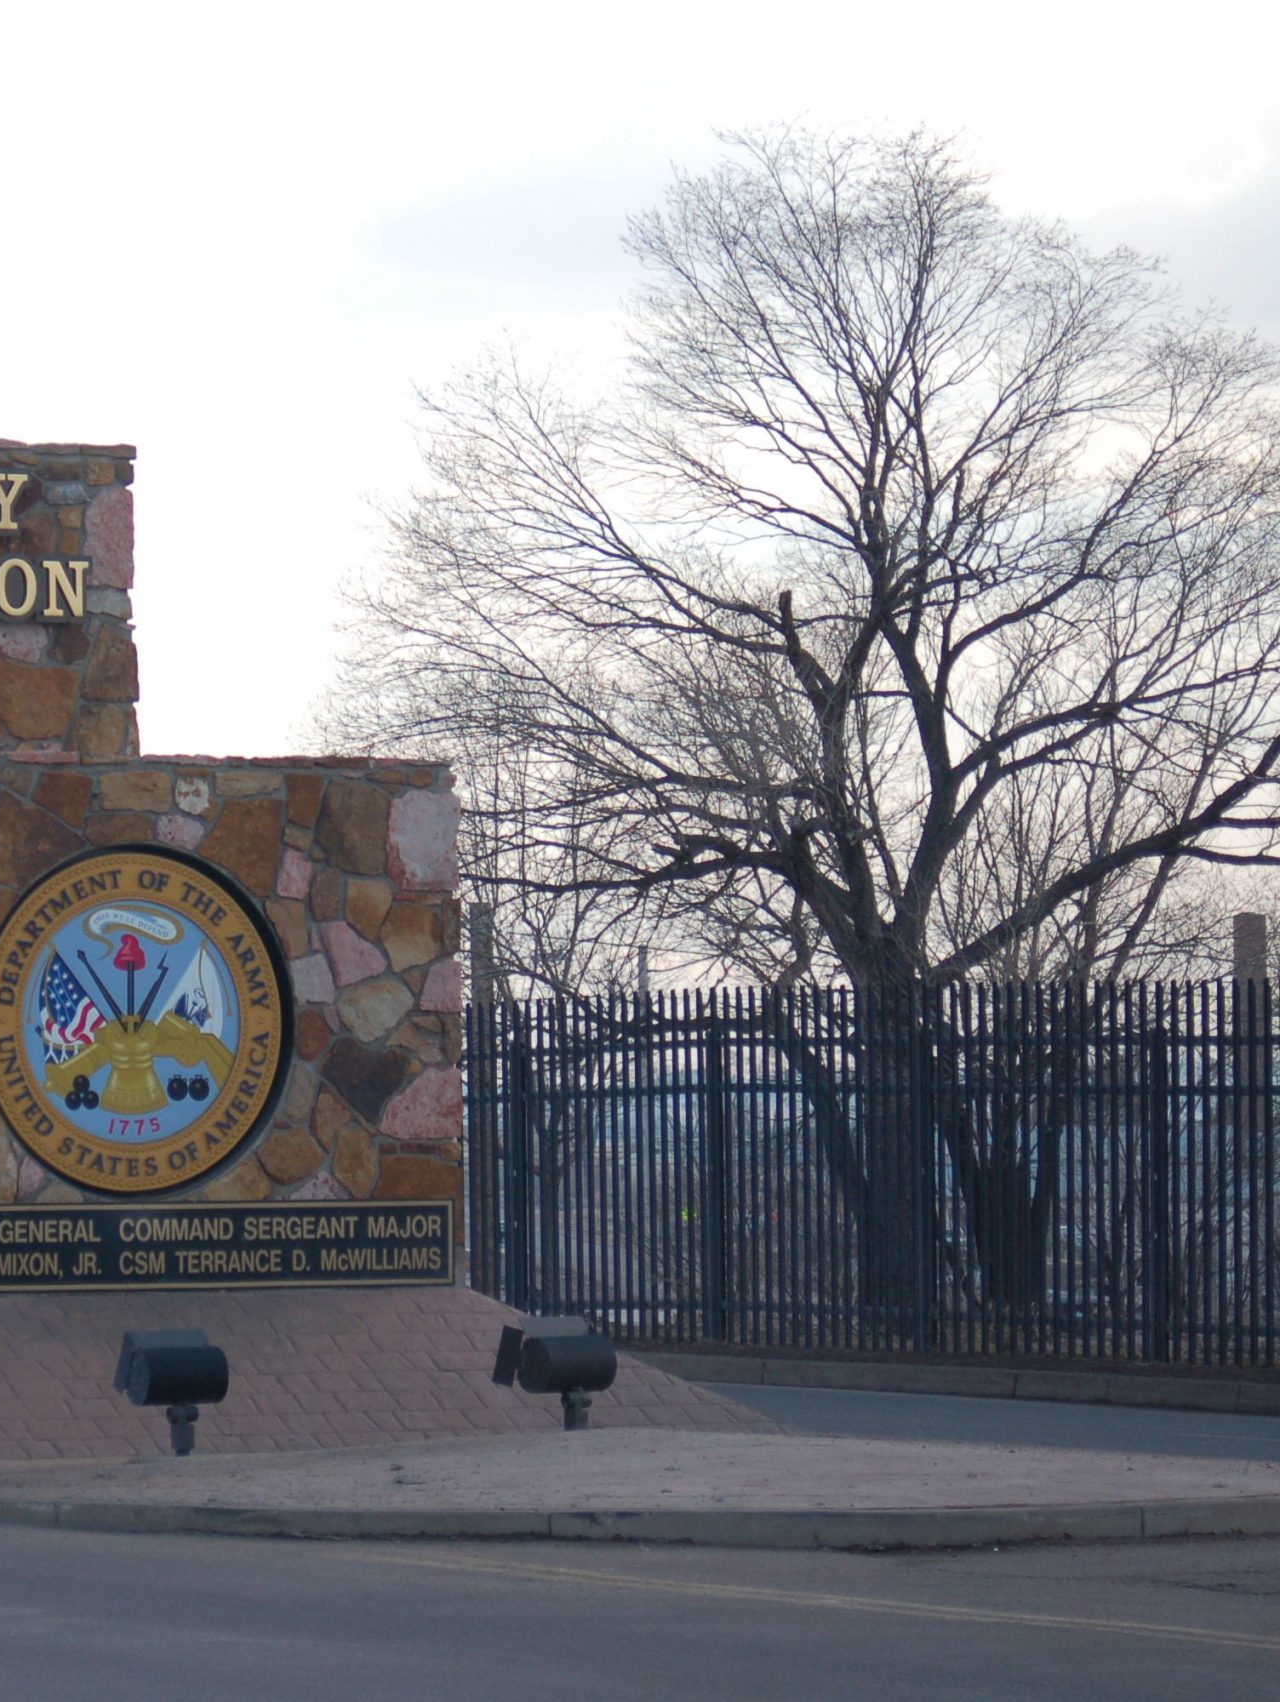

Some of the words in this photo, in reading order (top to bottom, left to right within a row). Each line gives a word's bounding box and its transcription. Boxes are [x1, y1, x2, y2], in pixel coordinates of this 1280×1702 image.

[137, 870, 170, 892] OF
[181, 881, 227, 927] THE
[226, 933, 270, 1010] ARMY
[58, 1137, 159, 1177] STATES
[169, 1141, 200, 1171] OF
[204, 1031, 270, 1150] AMERICA
[108, 1117, 161, 1135] 1775
[119, 1217, 234, 1242] COMMAND
[243, 1216, 358, 1240] SERGEANT
[368, 1215, 442, 1239] MAJOR
[72, 1252, 102, 1276] JR.
[119, 1251, 165, 1275] CSM
[175, 1249, 282, 1274] TERRANCE
[292, 1249, 310, 1272] D.
[321, 1247, 441, 1272] McWILLIAMS
